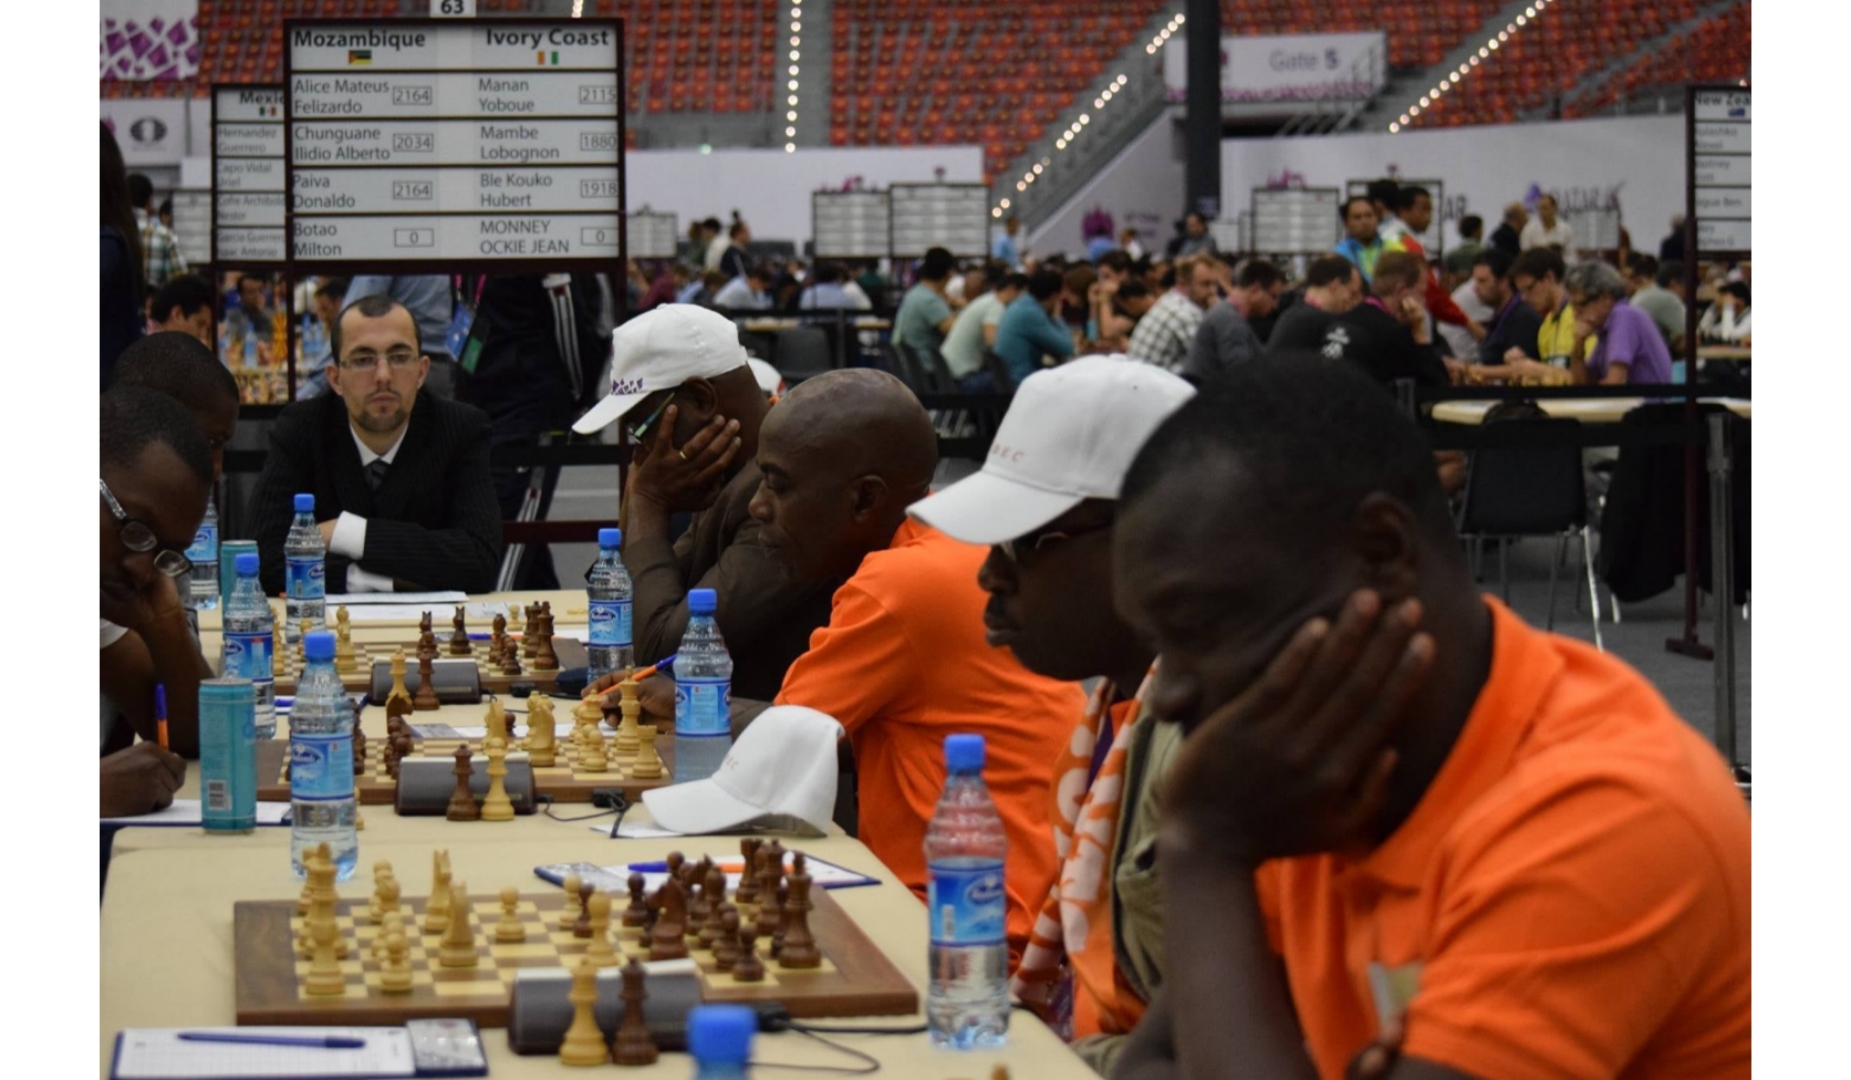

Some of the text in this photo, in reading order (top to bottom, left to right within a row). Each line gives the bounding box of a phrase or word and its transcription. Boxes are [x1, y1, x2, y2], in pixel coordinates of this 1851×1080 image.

[441, 0, 464, 14] 63
[294, 29, 426, 50] Mozambique
[487, 28, 609, 49] Ivory Coast
[1269, 48, 1319, 72] Gate
[294, 79, 390, 94] Alice Mateus
[479, 78, 529, 93] Manan
[396, 89, 430, 103] 2164
[582, 88, 616, 102] 2115
[294, 100, 362, 114] Felizardo
[479, 98, 535, 112] Yoboue
[295, 127, 381, 143] Chunguane
[481, 126, 539, 140] Mambe
[396, 136, 431, 150] 2034
[583, 135, 616, 149] 1880
[295, 146, 390, 160] Ilidio Alberto
[481, 146, 560, 163] Lobognon
[245, 162, 272, 173] Vidal
[293, 175, 330, 189] Paiva
[481, 174, 552, 188] Ble Kouko
[396, 184, 430, 198] 2164
[583, 183, 617, 196] 1918
[293, 194, 356, 208] Donaldo
[481, 193, 532, 207] Hubert
[293, 222, 337, 237] Botao
[481, 221, 551, 235] MONNEY
[409, 232, 419, 245] 0
[596, 230, 605, 243] 0
[293, 243, 342, 256] Milton
[480, 240, 569, 255] OCKIE JEAN
